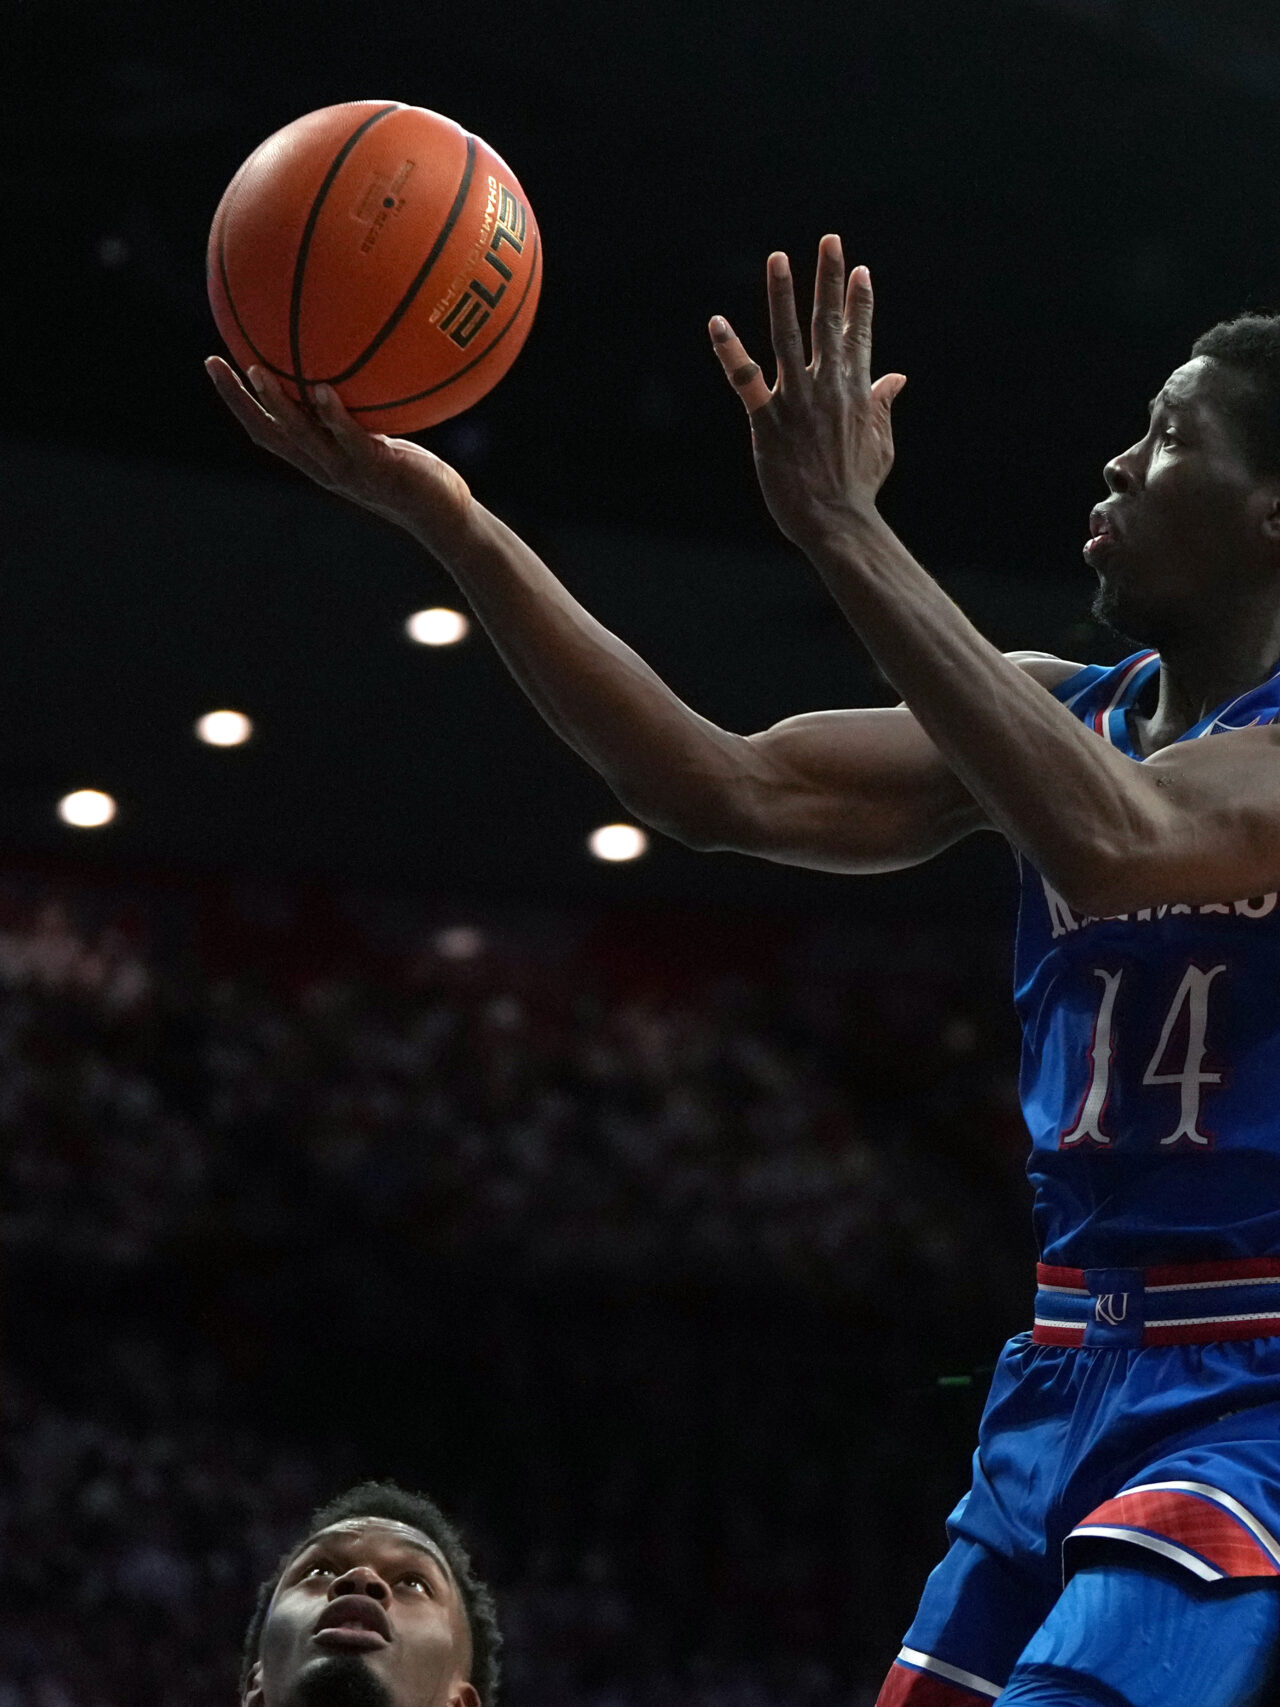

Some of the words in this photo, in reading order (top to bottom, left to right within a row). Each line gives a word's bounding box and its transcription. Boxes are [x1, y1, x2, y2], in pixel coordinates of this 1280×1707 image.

[437, 182, 527, 351] ELITE
[1061, 962, 1228, 1148] 14
[1094, 1292, 1130, 1326] KU
